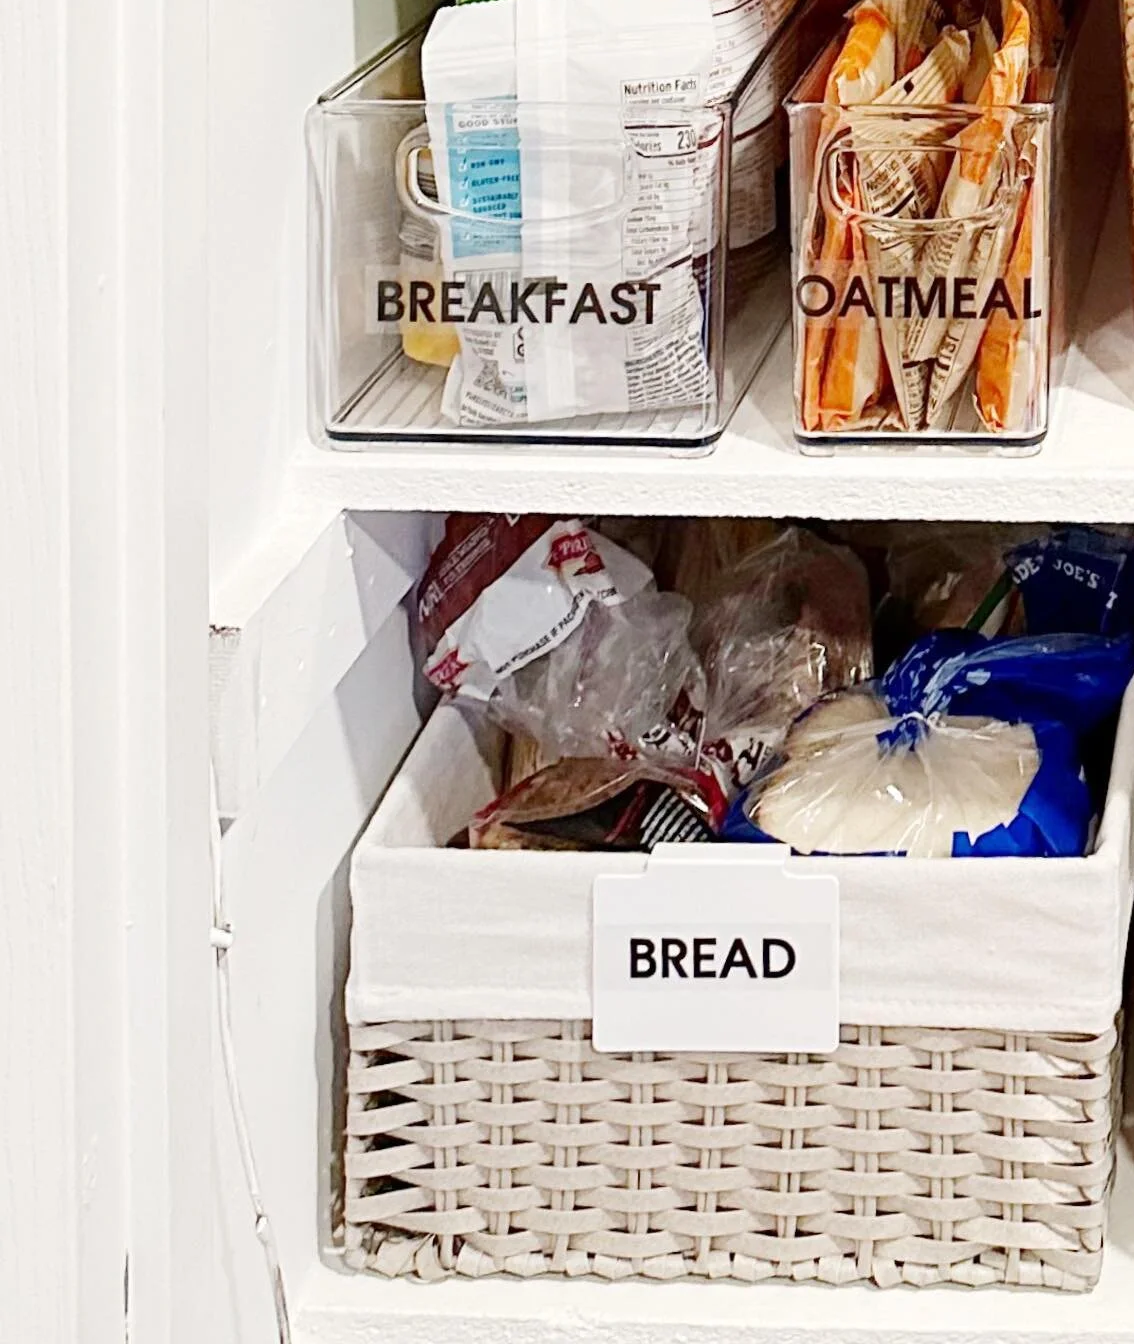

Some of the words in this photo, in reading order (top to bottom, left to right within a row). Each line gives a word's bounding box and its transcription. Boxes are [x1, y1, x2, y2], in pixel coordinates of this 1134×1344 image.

[623, 80, 672, 95] Nutrition
[674, 78, 697, 92] Facts
[676, 128, 698, 151] 230
[375, 280, 662, 326] BREAKFAST
[796, 274, 1043, 320] OATMEAL
[1052, 558, 1101, 590] JOE'S
[629, 936, 797, 980] BREAD
